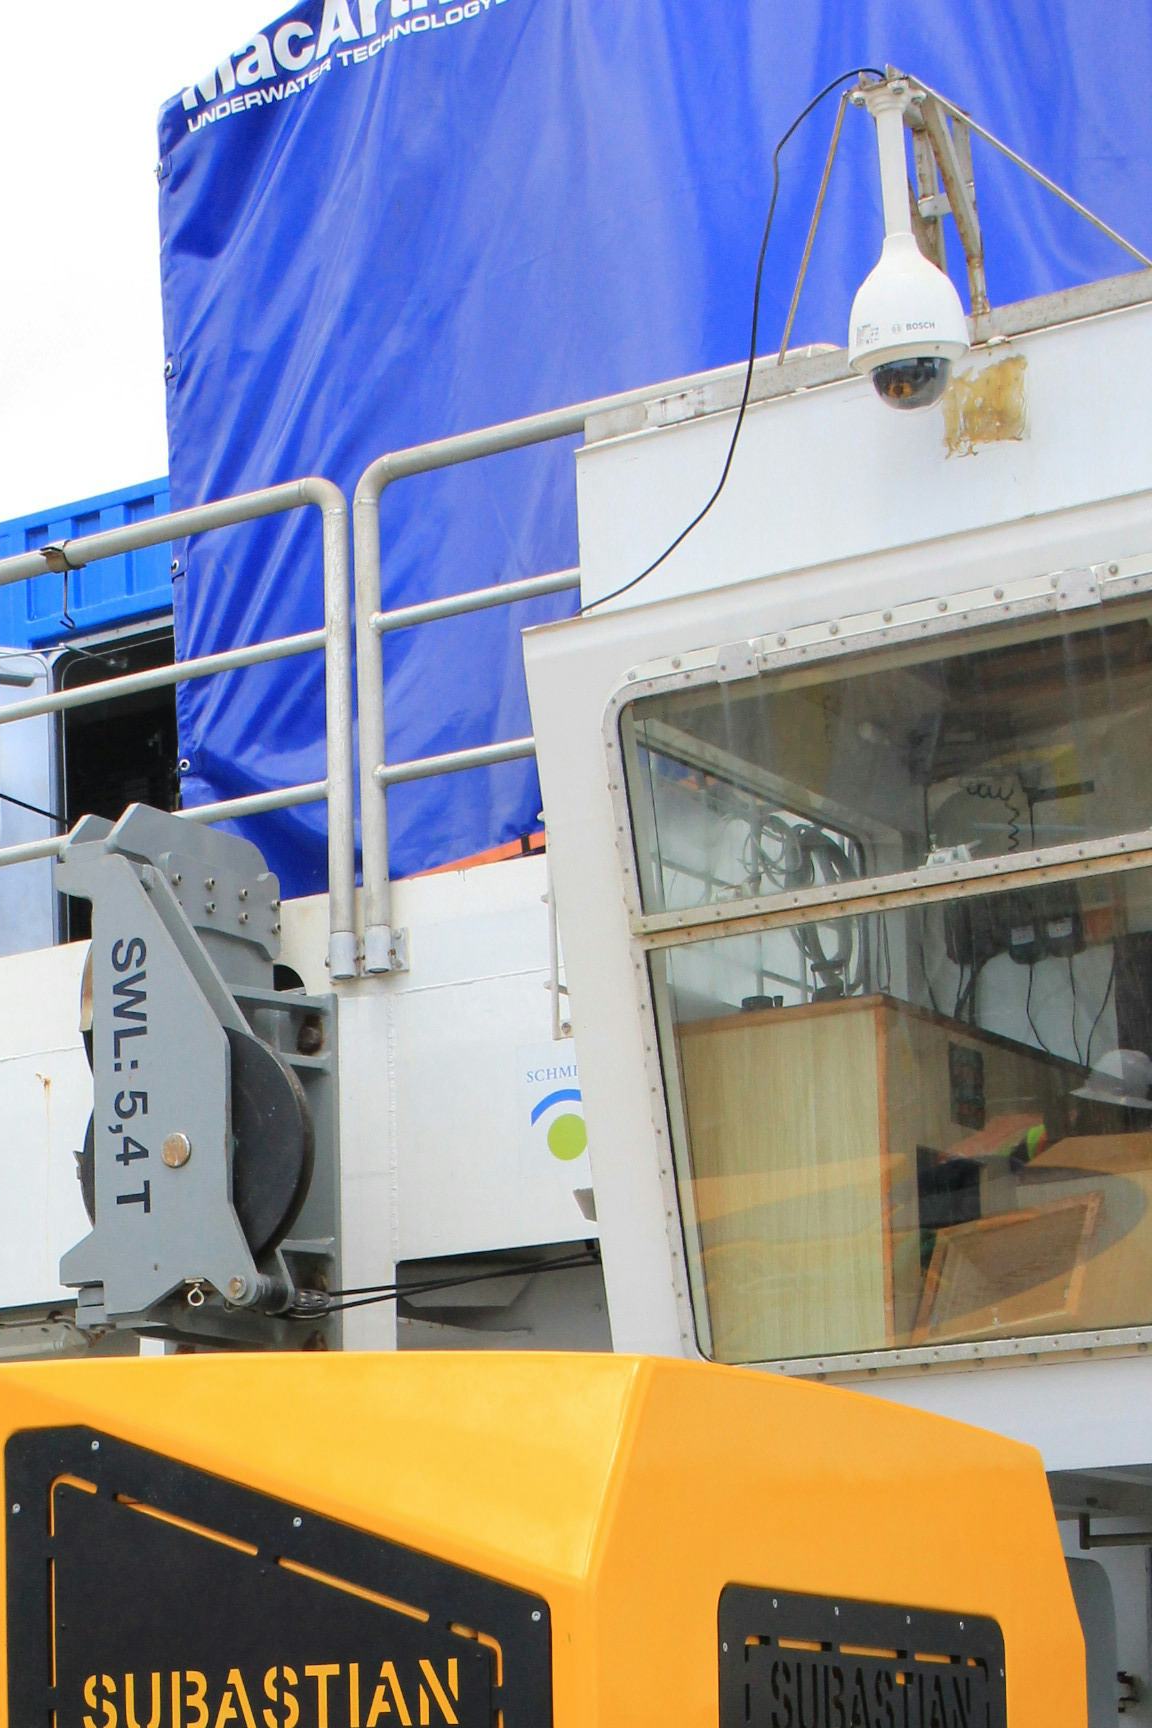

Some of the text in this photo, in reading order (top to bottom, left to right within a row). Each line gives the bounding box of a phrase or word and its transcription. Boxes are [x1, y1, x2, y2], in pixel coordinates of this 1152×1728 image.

[187, 57, 332, 133] UNDERWATER
[906, 322, 935, 331] BOSCH
[111, 936, 148, 1073] SWL:
[116, 1179, 151, 1214] T
